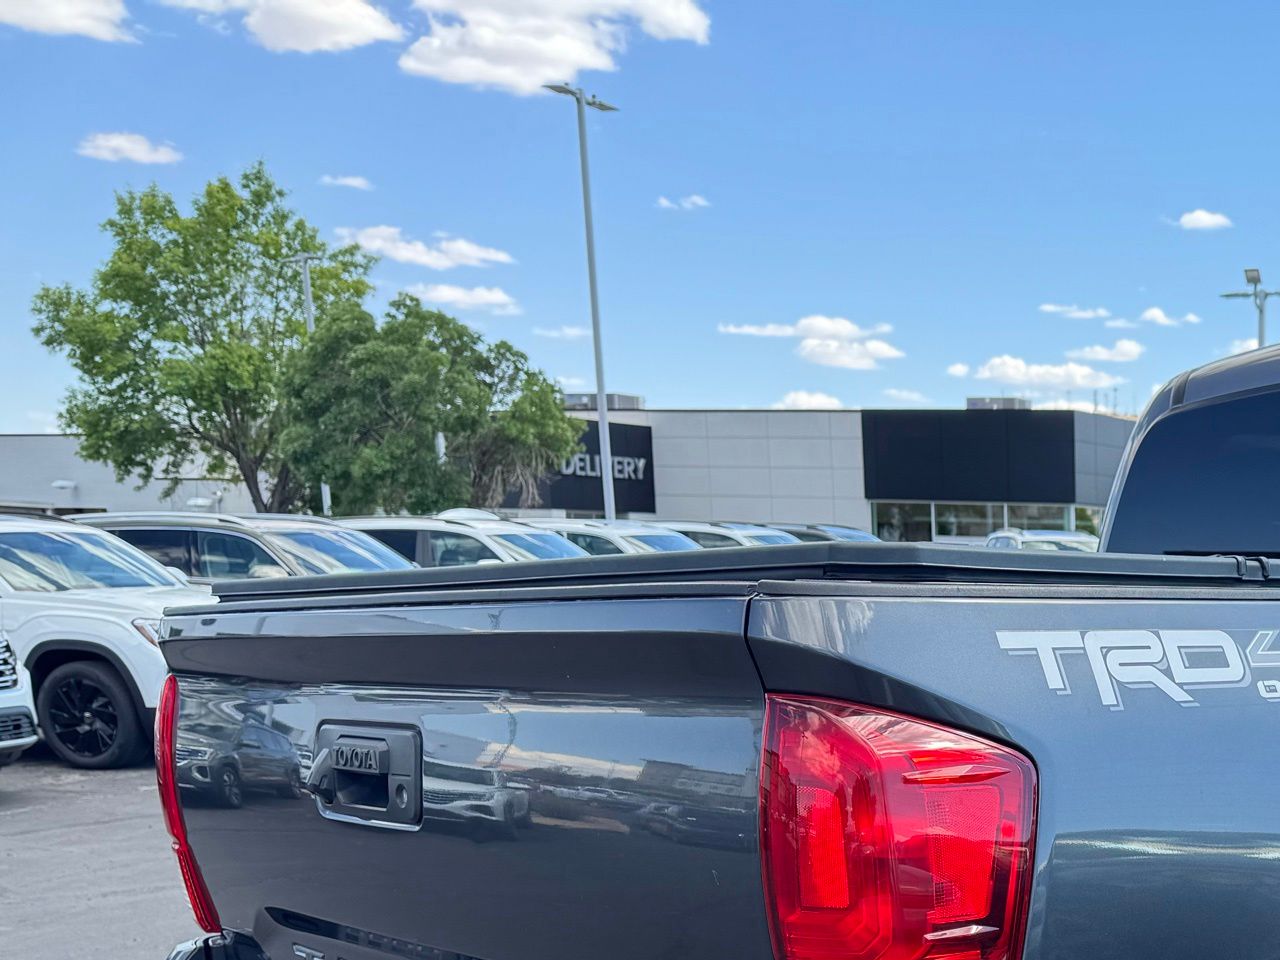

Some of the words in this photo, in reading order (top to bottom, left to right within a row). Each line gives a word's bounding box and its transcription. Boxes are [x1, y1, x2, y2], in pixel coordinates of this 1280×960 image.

[561, 453, 646, 480] DELIERY
[996, 630, 1250, 710] TRD
[332, 745, 378, 769] TOYOTA
